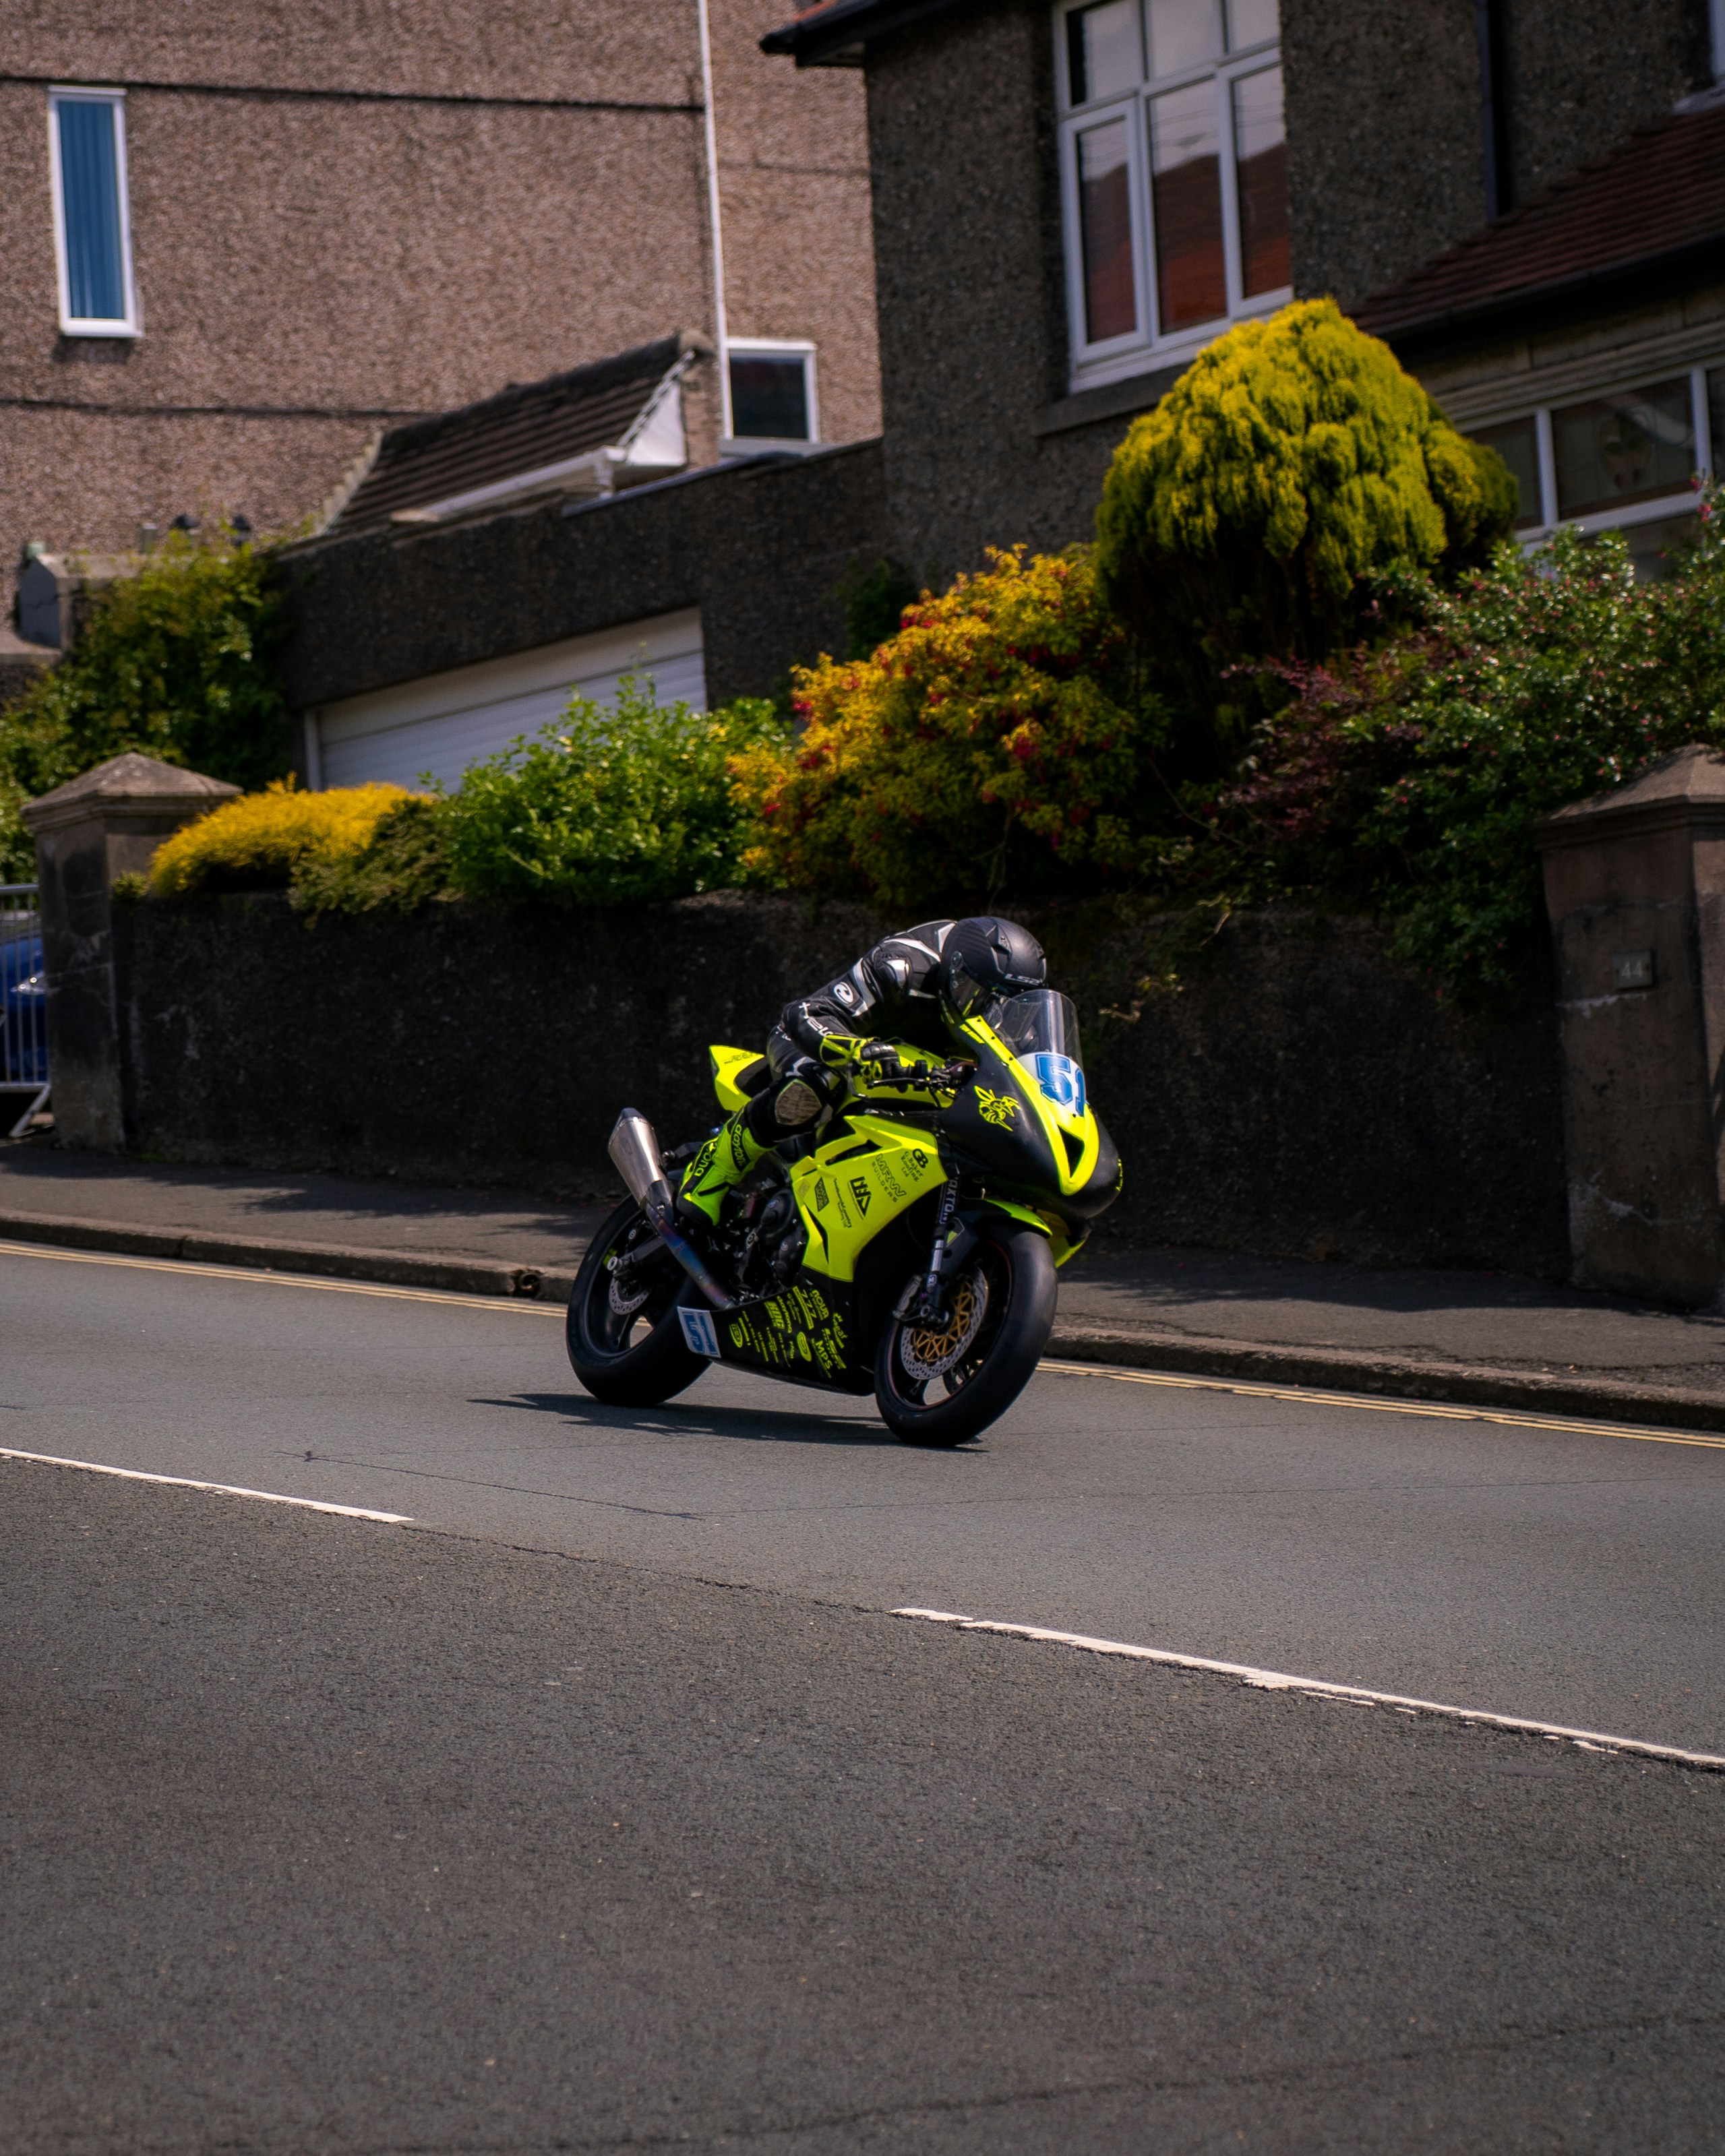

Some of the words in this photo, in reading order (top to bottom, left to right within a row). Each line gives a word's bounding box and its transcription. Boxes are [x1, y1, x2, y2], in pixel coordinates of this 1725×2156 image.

[1035, 1054, 1085, 1117] 51
[872, 1161, 898, 1203] BUILDERS
[876, 1153, 907, 1198] MRW
[901, 1155, 919, 1182] Roofing
[682, 1312, 719, 1356] 51
[815, 1340, 833, 1370] MPS
